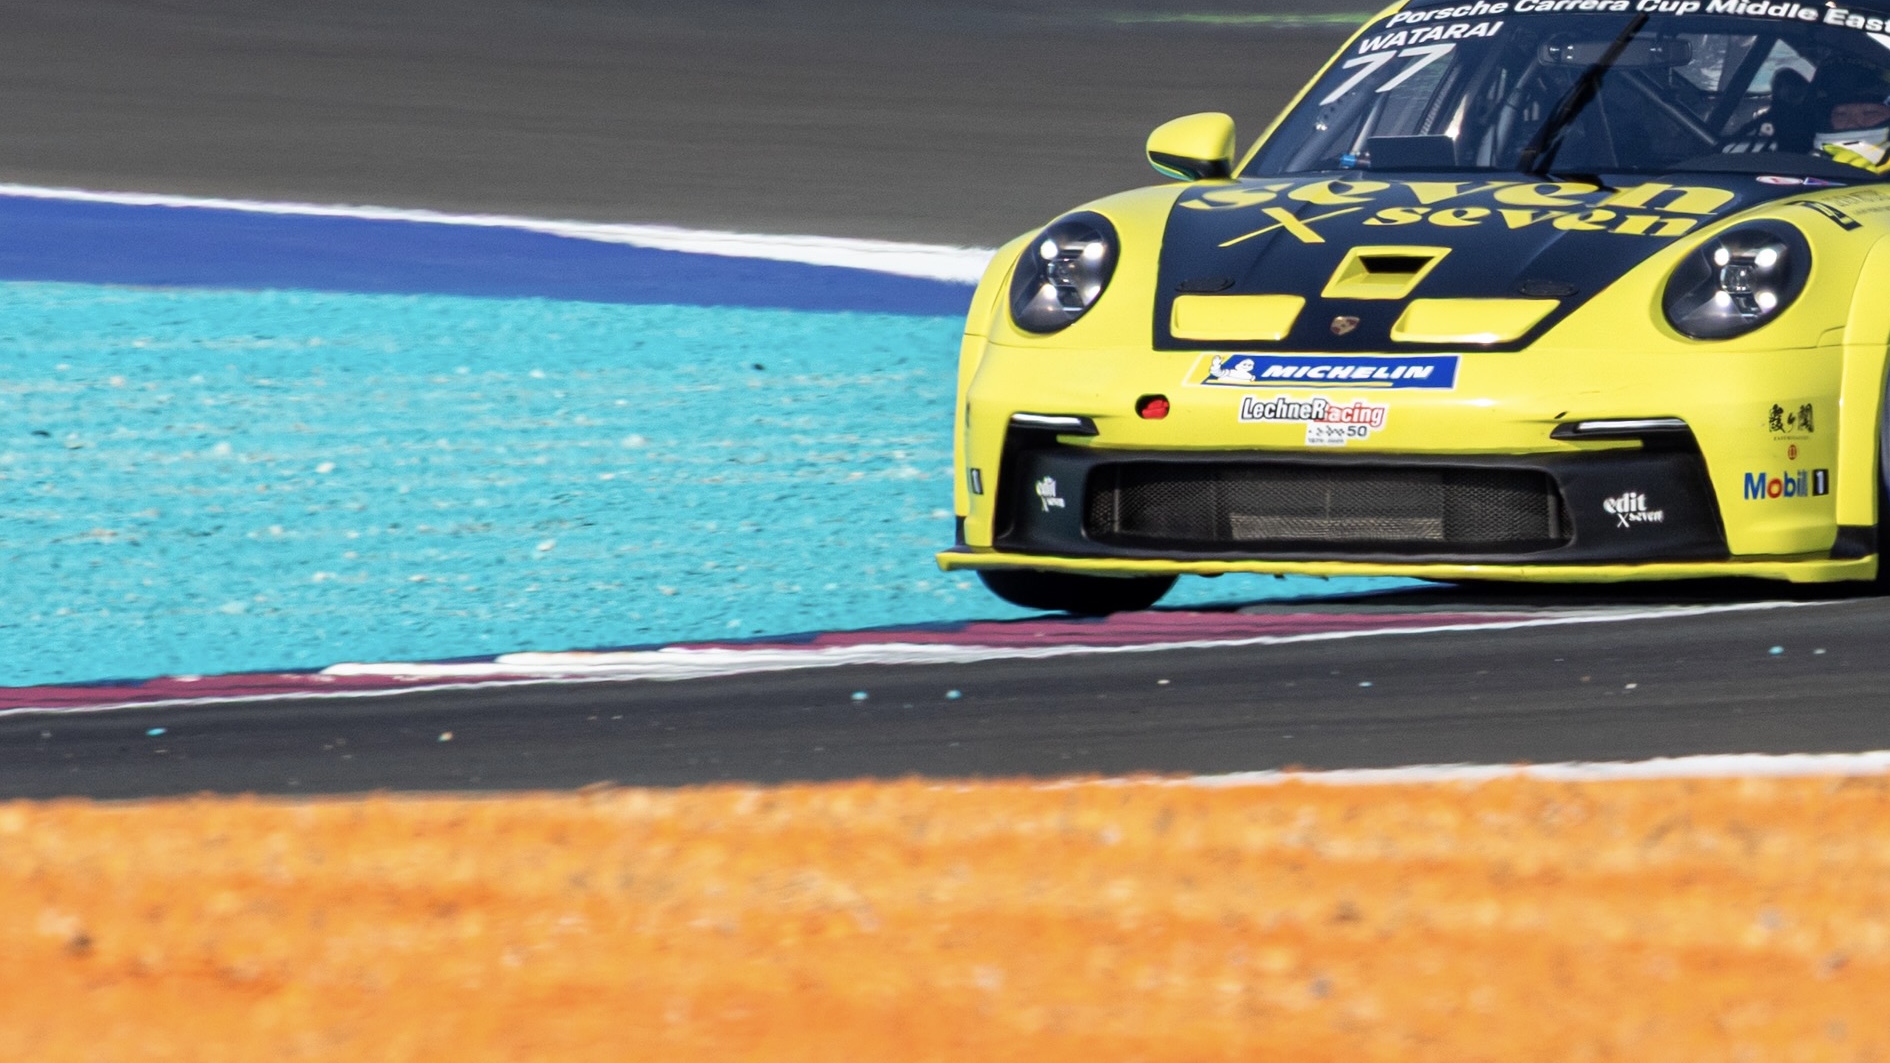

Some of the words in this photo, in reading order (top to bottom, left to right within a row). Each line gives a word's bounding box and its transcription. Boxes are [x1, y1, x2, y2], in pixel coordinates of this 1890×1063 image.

[1386, 0, 1509, 28] Porsche
[1358, 21, 1504, 55] WATARAI
[1319, 43, 1457, 106] 77
[1179, 179, 1735, 215] seven
[1362, 207, 1699, 237] seven
[1261, 364, 1434, 379] MICHELIN
[1347, 425, 1368, 437] 50
[1744, 469, 1808, 500] Mobil
[1815, 470, 1826, 495] 1
[1603, 492, 1647, 513] edit
